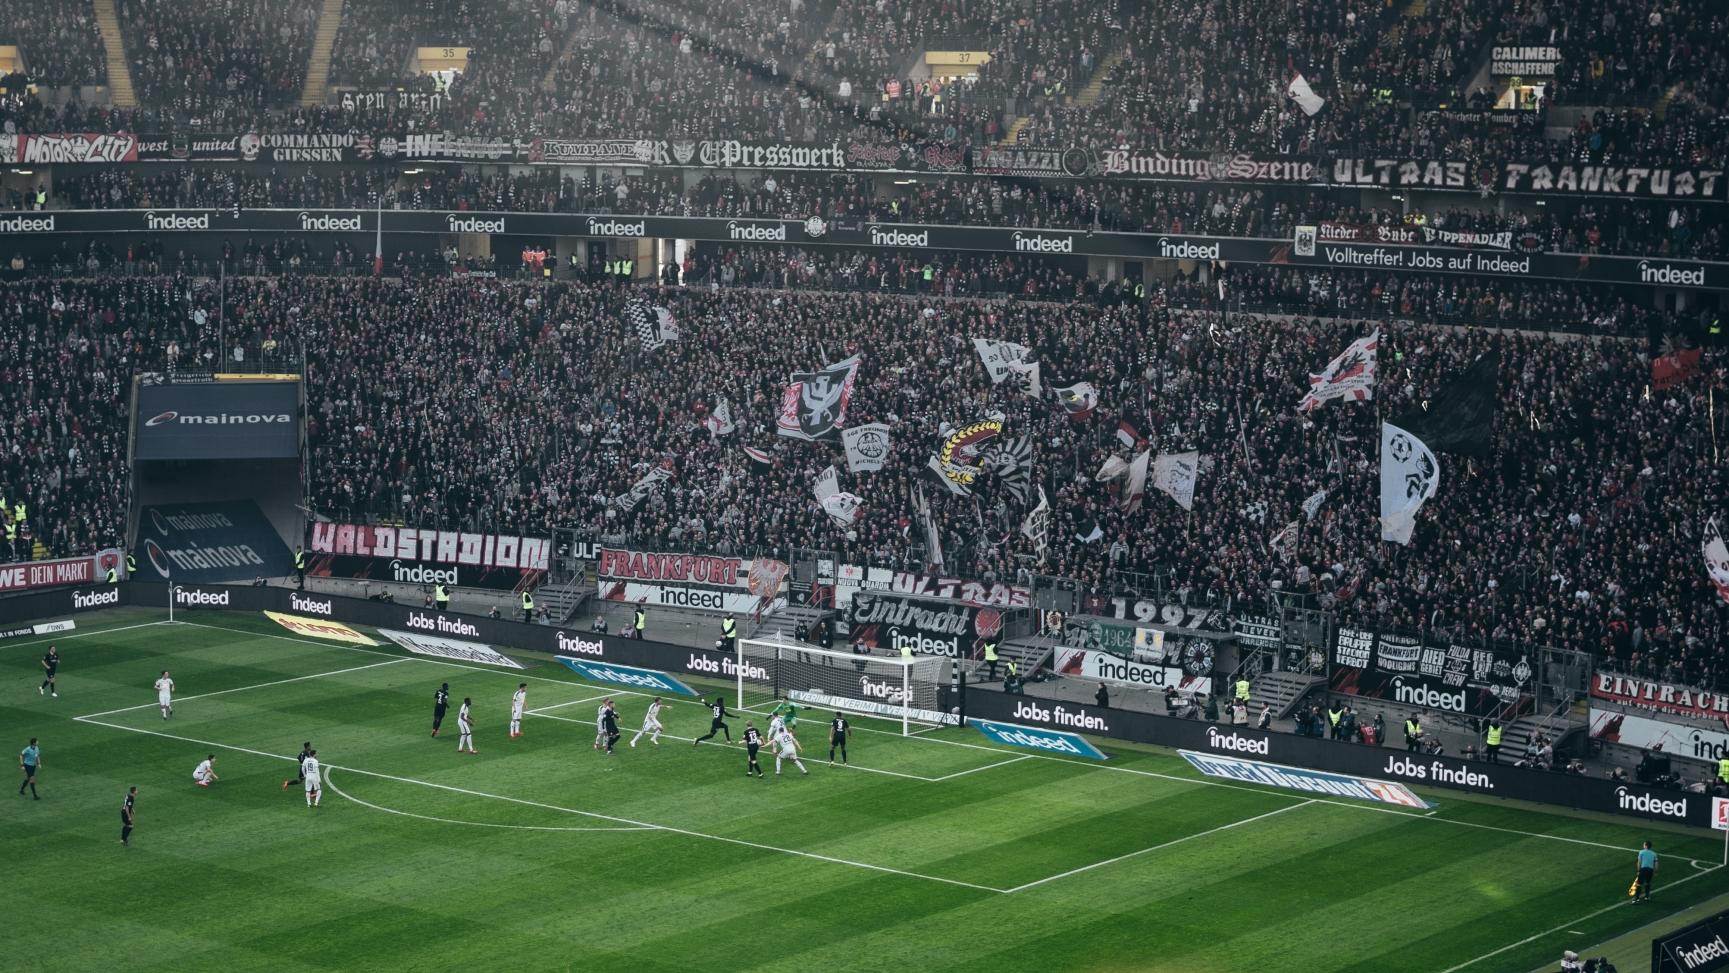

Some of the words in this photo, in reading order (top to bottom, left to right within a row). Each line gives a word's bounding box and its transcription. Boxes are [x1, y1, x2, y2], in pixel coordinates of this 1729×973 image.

[442, 48, 455, 58] 35
[959, 53, 971, 63] 37
[24, 135, 76, 163] MOTOR
[138, 139, 168, 153] west
[192, 137, 236, 152] united
[260, 133, 354, 150] COMMANDO
[273, 147, 343, 162] GIESSEN
[1102, 151, 1213, 180] Binding
[1228, 154, 1314, 180] Szene
[1333, 159, 1467, 188] ULTRAS
[1504, 163, 1724, 197] FRANKFURT
[0, 215, 54, 233] ndeed
[147, 212, 208, 230] indeed
[301, 214, 361, 231] indeed
[449, 216, 505, 234] indeed
[589, 218, 645, 237] indeed
[729, 223, 786, 241] indeed
[872, 228, 928, 248] indeed
[1015, 233, 1072, 253] indeed
[1161, 239, 1220, 260] indeed
[1325, 246, 1403, 267] Volltreffer!
[1407, 250, 1443, 269] Jobs
[1447, 252, 1472, 270] auf
[1476, 255, 1530, 273] Indeed
[1641, 263, 1704, 285] indeed
[179, 411, 291, 425] mainova
[166, 510, 233, 531] mainova
[167, 540, 264, 570] mainova
[311, 522, 552, 570] WALDSTADION
[31, 565, 54, 584] DEIN
[57, 562, 88, 582] MARKT
[394, 561, 458, 586] indeed
[598, 548, 741, 585] FRANKFURT
[74, 587, 119, 609] indeed
[176, 586, 229, 606] indeed
[660, 586, 724, 610] indeed
[893, 572, 1032, 609] ULTRAS
[292, 595, 332, 616] indeed
[854, 591, 971, 637] Eintracht
[407, 611, 435, 631] Jobs
[437, 615, 480, 637] finden.
[1241, 613, 1279, 627] ULTRAS
[558, 635, 603, 656] indeed
[891, 629, 958, 658] indeed
[1379, 643, 1420, 659] FRANKFURT
[1447, 644, 1471, 660] FULDA
[687, 655, 719, 673] Jobs
[722, 656, 770, 681] finden.
[1098, 657, 1166, 687] indeed
[1395, 680, 1466, 713] indeed
[1598, 673, 1729, 713] EINTRACH
[1013, 701, 1050, 723] Jobs
[1053, 706, 1109, 731] finden.
[749, 732, 757, 744] 13
[997, 728, 1082, 754] indeed
[1211, 731, 1269, 755] indeed
[1384, 755, 1426, 778] Jobs
[1431, 761, 1495, 789] finden.
[1619, 788, 1687, 818] indeed
[1683, 935, 1729, 970] indeed
